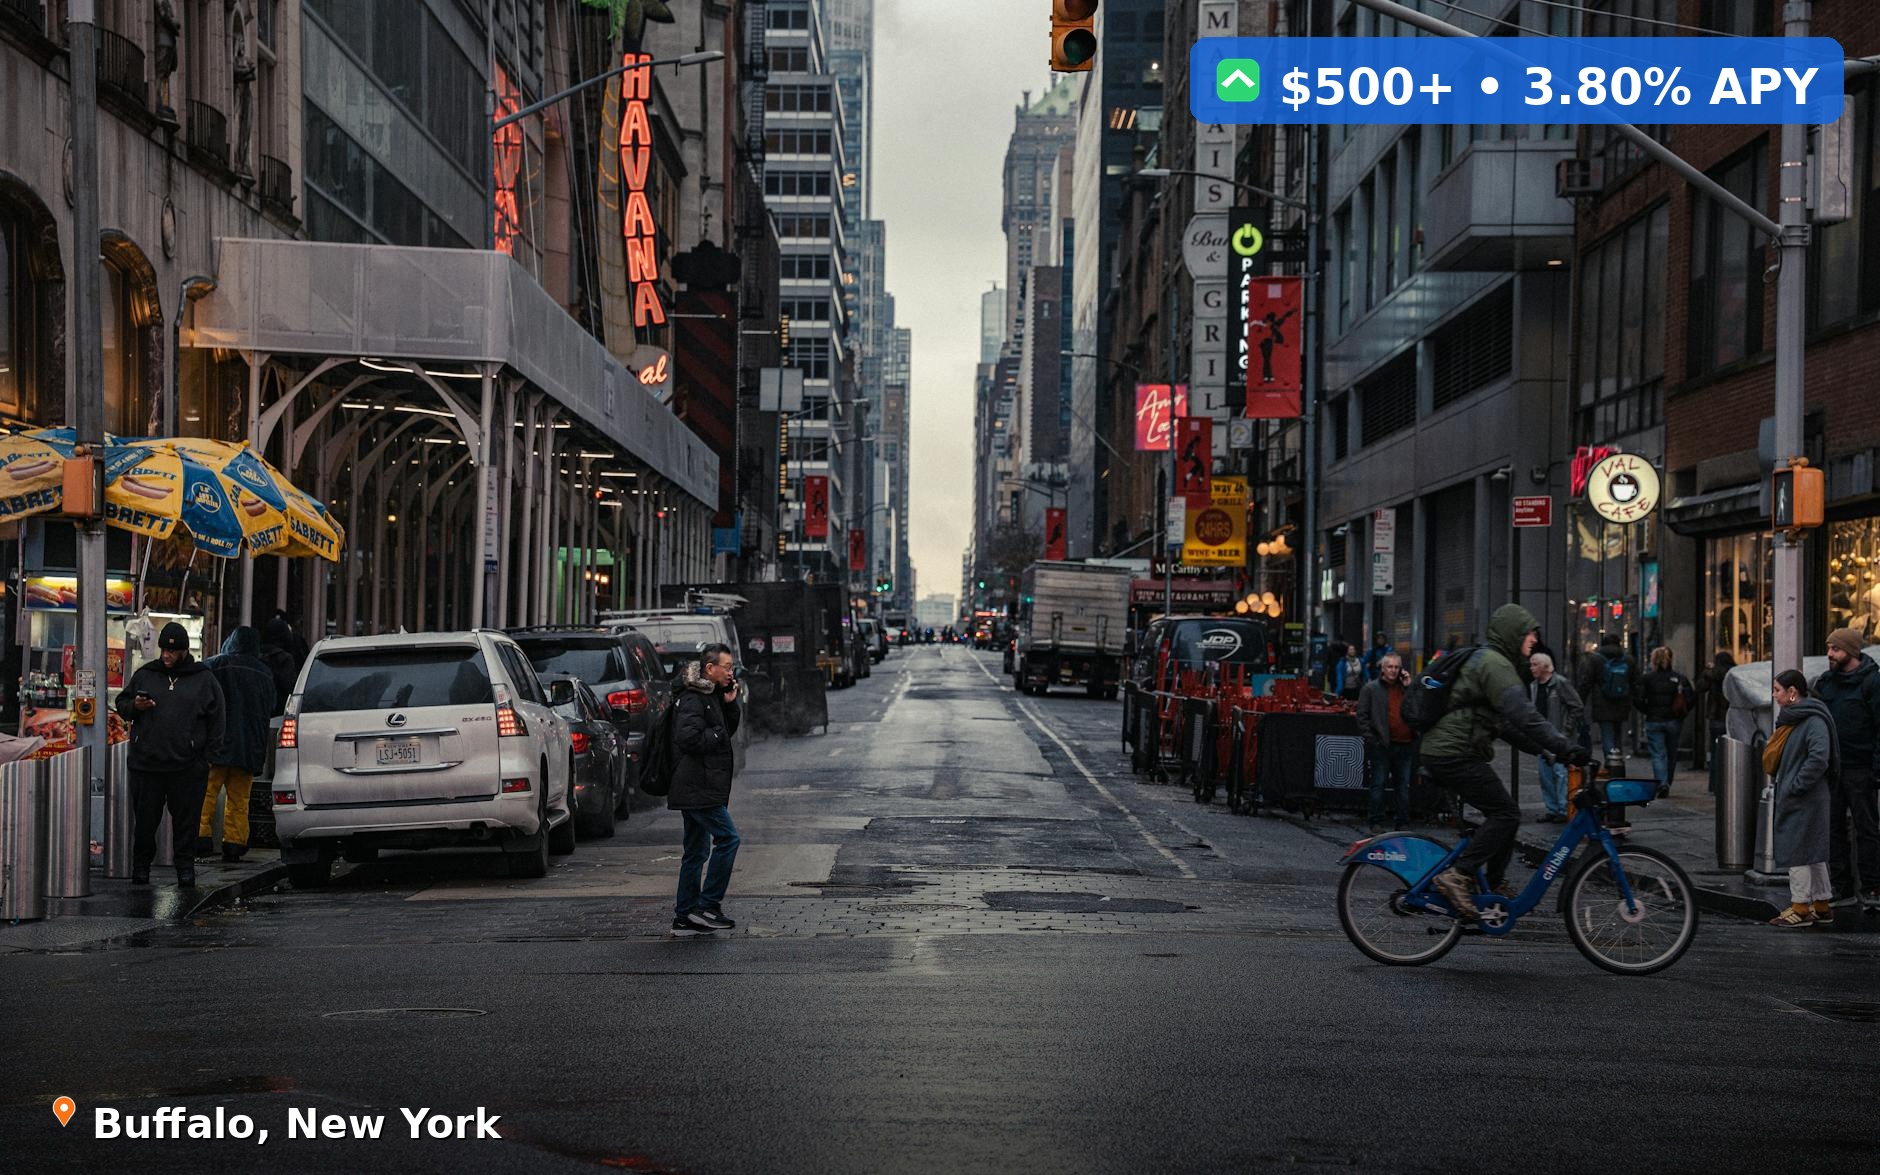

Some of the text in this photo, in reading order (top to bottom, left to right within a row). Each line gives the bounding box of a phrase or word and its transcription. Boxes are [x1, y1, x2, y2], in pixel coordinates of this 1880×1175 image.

[619, 53, 666, 327] HAVANA
[1600, 456, 1641, 478] VAL
[105, 501, 173, 533] BRETT
[1598, 497, 1651, 520] CAFE
[290, 515, 335, 554] SABRETT
[1199, 520, 1230, 538] 24HRS
[1187, 549, 1240, 557] WINE BEER
[1155, 592, 1209, 601] RETAURANT
